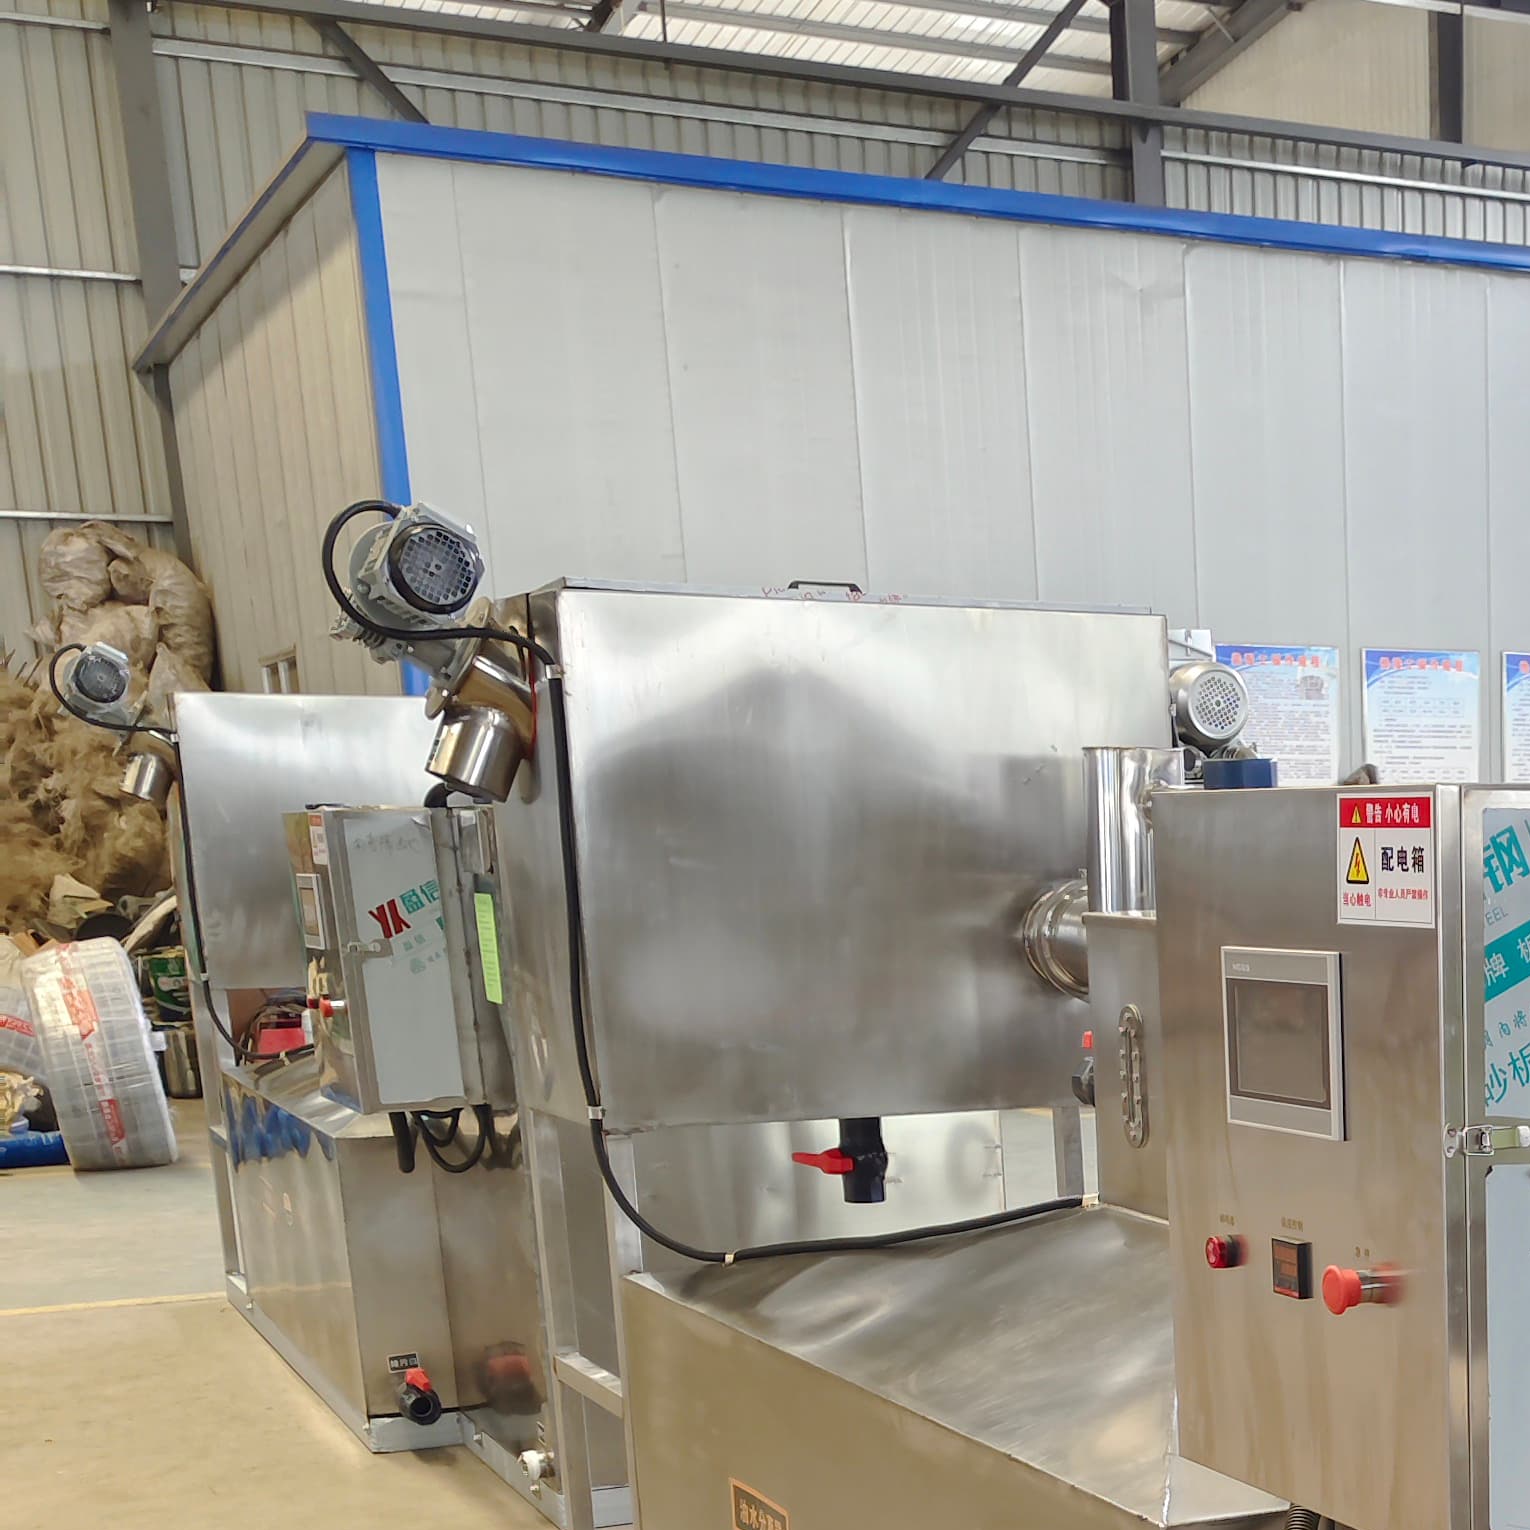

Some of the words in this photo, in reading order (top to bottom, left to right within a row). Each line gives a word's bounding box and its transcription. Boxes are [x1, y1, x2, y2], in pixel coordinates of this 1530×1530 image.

[1365, 803, 1382, 824] 警告
[1385, 802, 1420, 824] 小心有电
[1381, 846, 1425, 873] 配电箱
[1484, 952, 1509, 986] 牌
